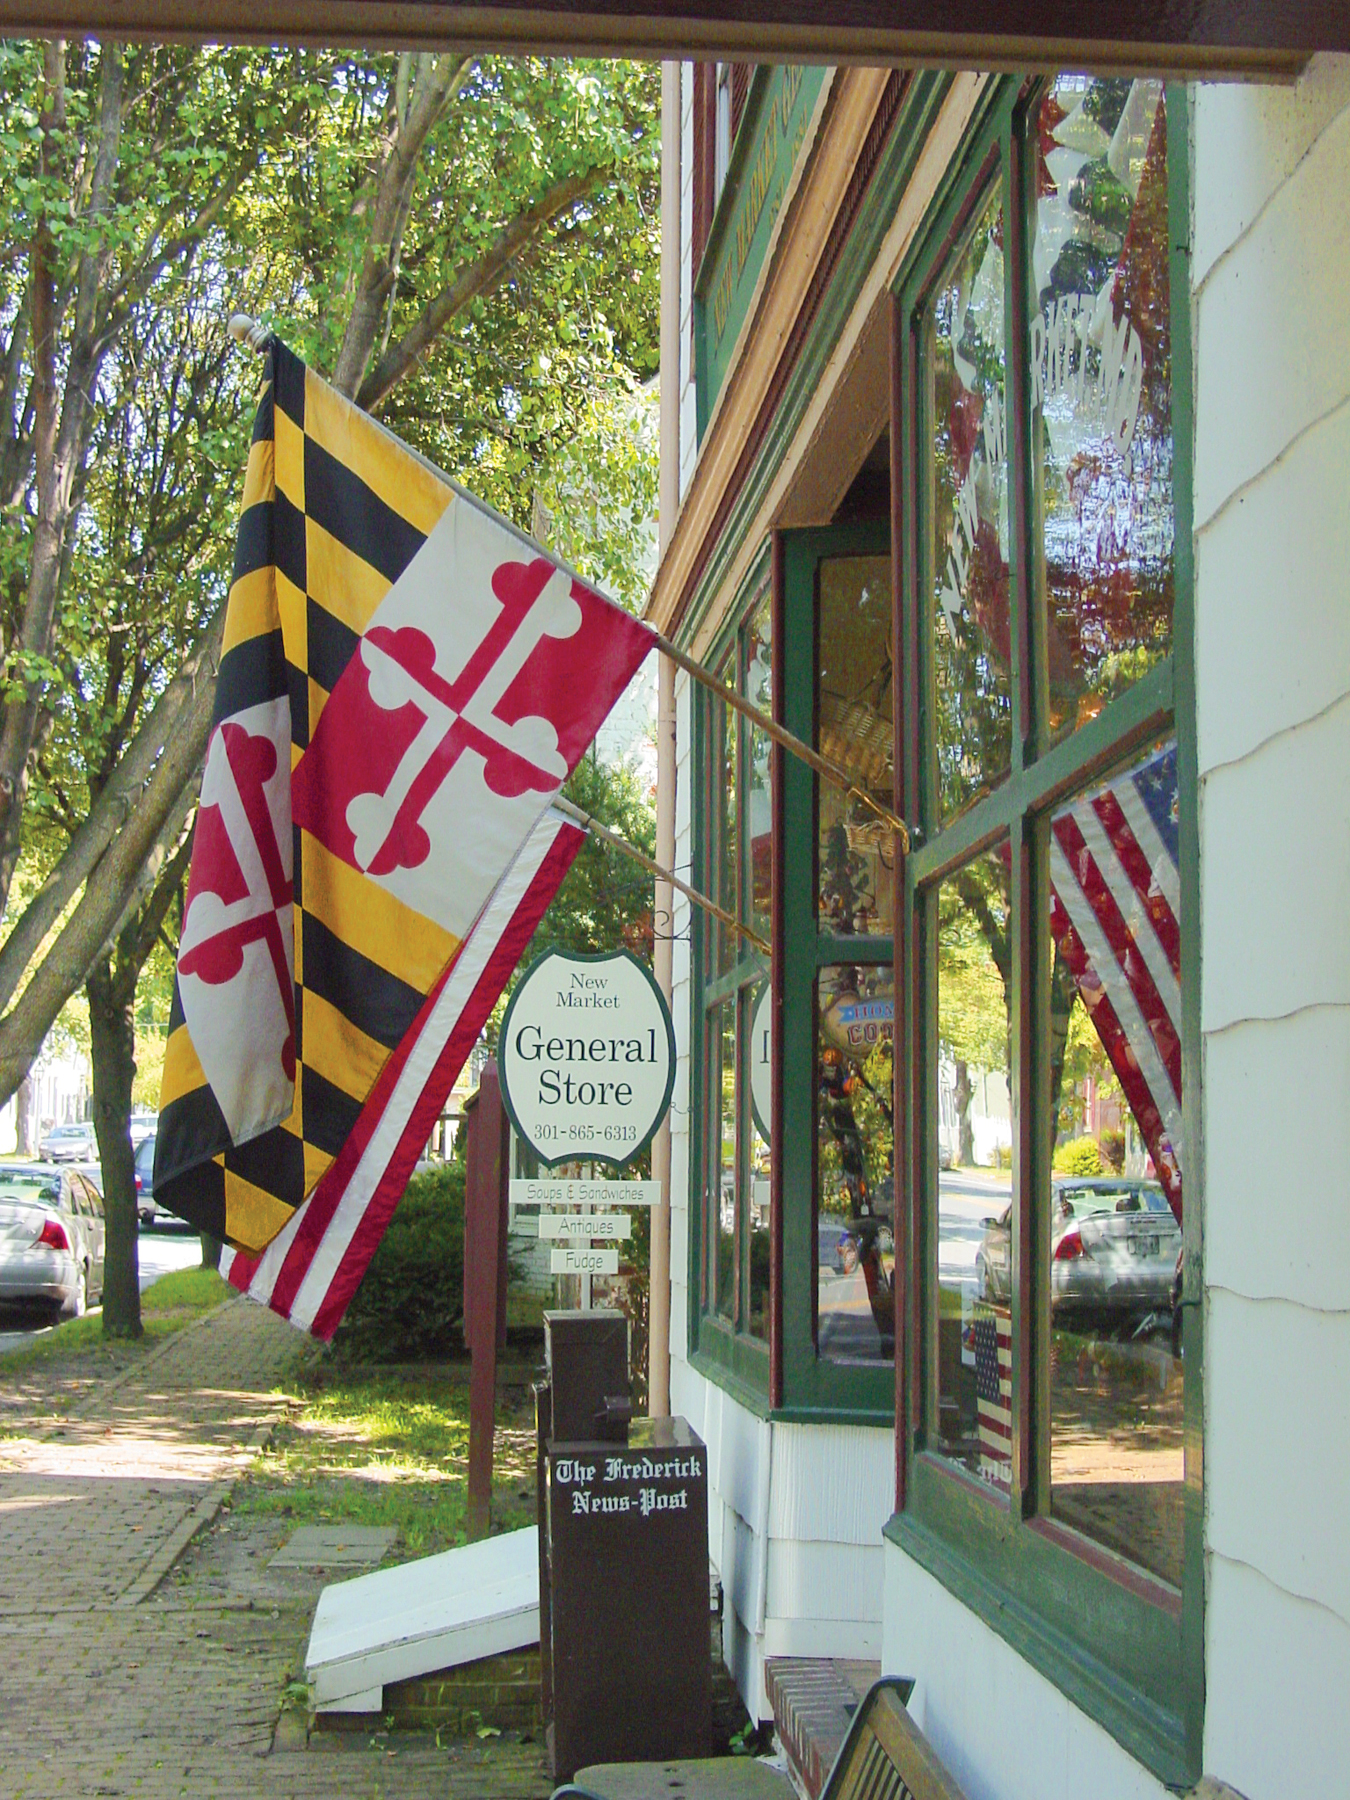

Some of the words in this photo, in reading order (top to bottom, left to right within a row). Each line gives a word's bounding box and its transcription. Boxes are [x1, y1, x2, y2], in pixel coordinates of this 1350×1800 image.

[570, 973, 608, 989] New
[556, 991, 620, 1009] Market
[515, 1025, 658, 1063] General
[538, 1069, 633, 1106] Store
[534, 1124, 637, 1142] 301-865-6313
[527, 1184, 562, 1200] Soups
[567, 1184, 575, 1200] &
[579, 1184, 644, 1200] Sandwiches
[558, 1217, 614, 1237] Antiques
[566, 1252, 604, 1271] Fudge
[555, 1459, 597, 1487] The
[603, 1455, 702, 1482] Frederick
[571, 1488, 688, 1516] News-Post
